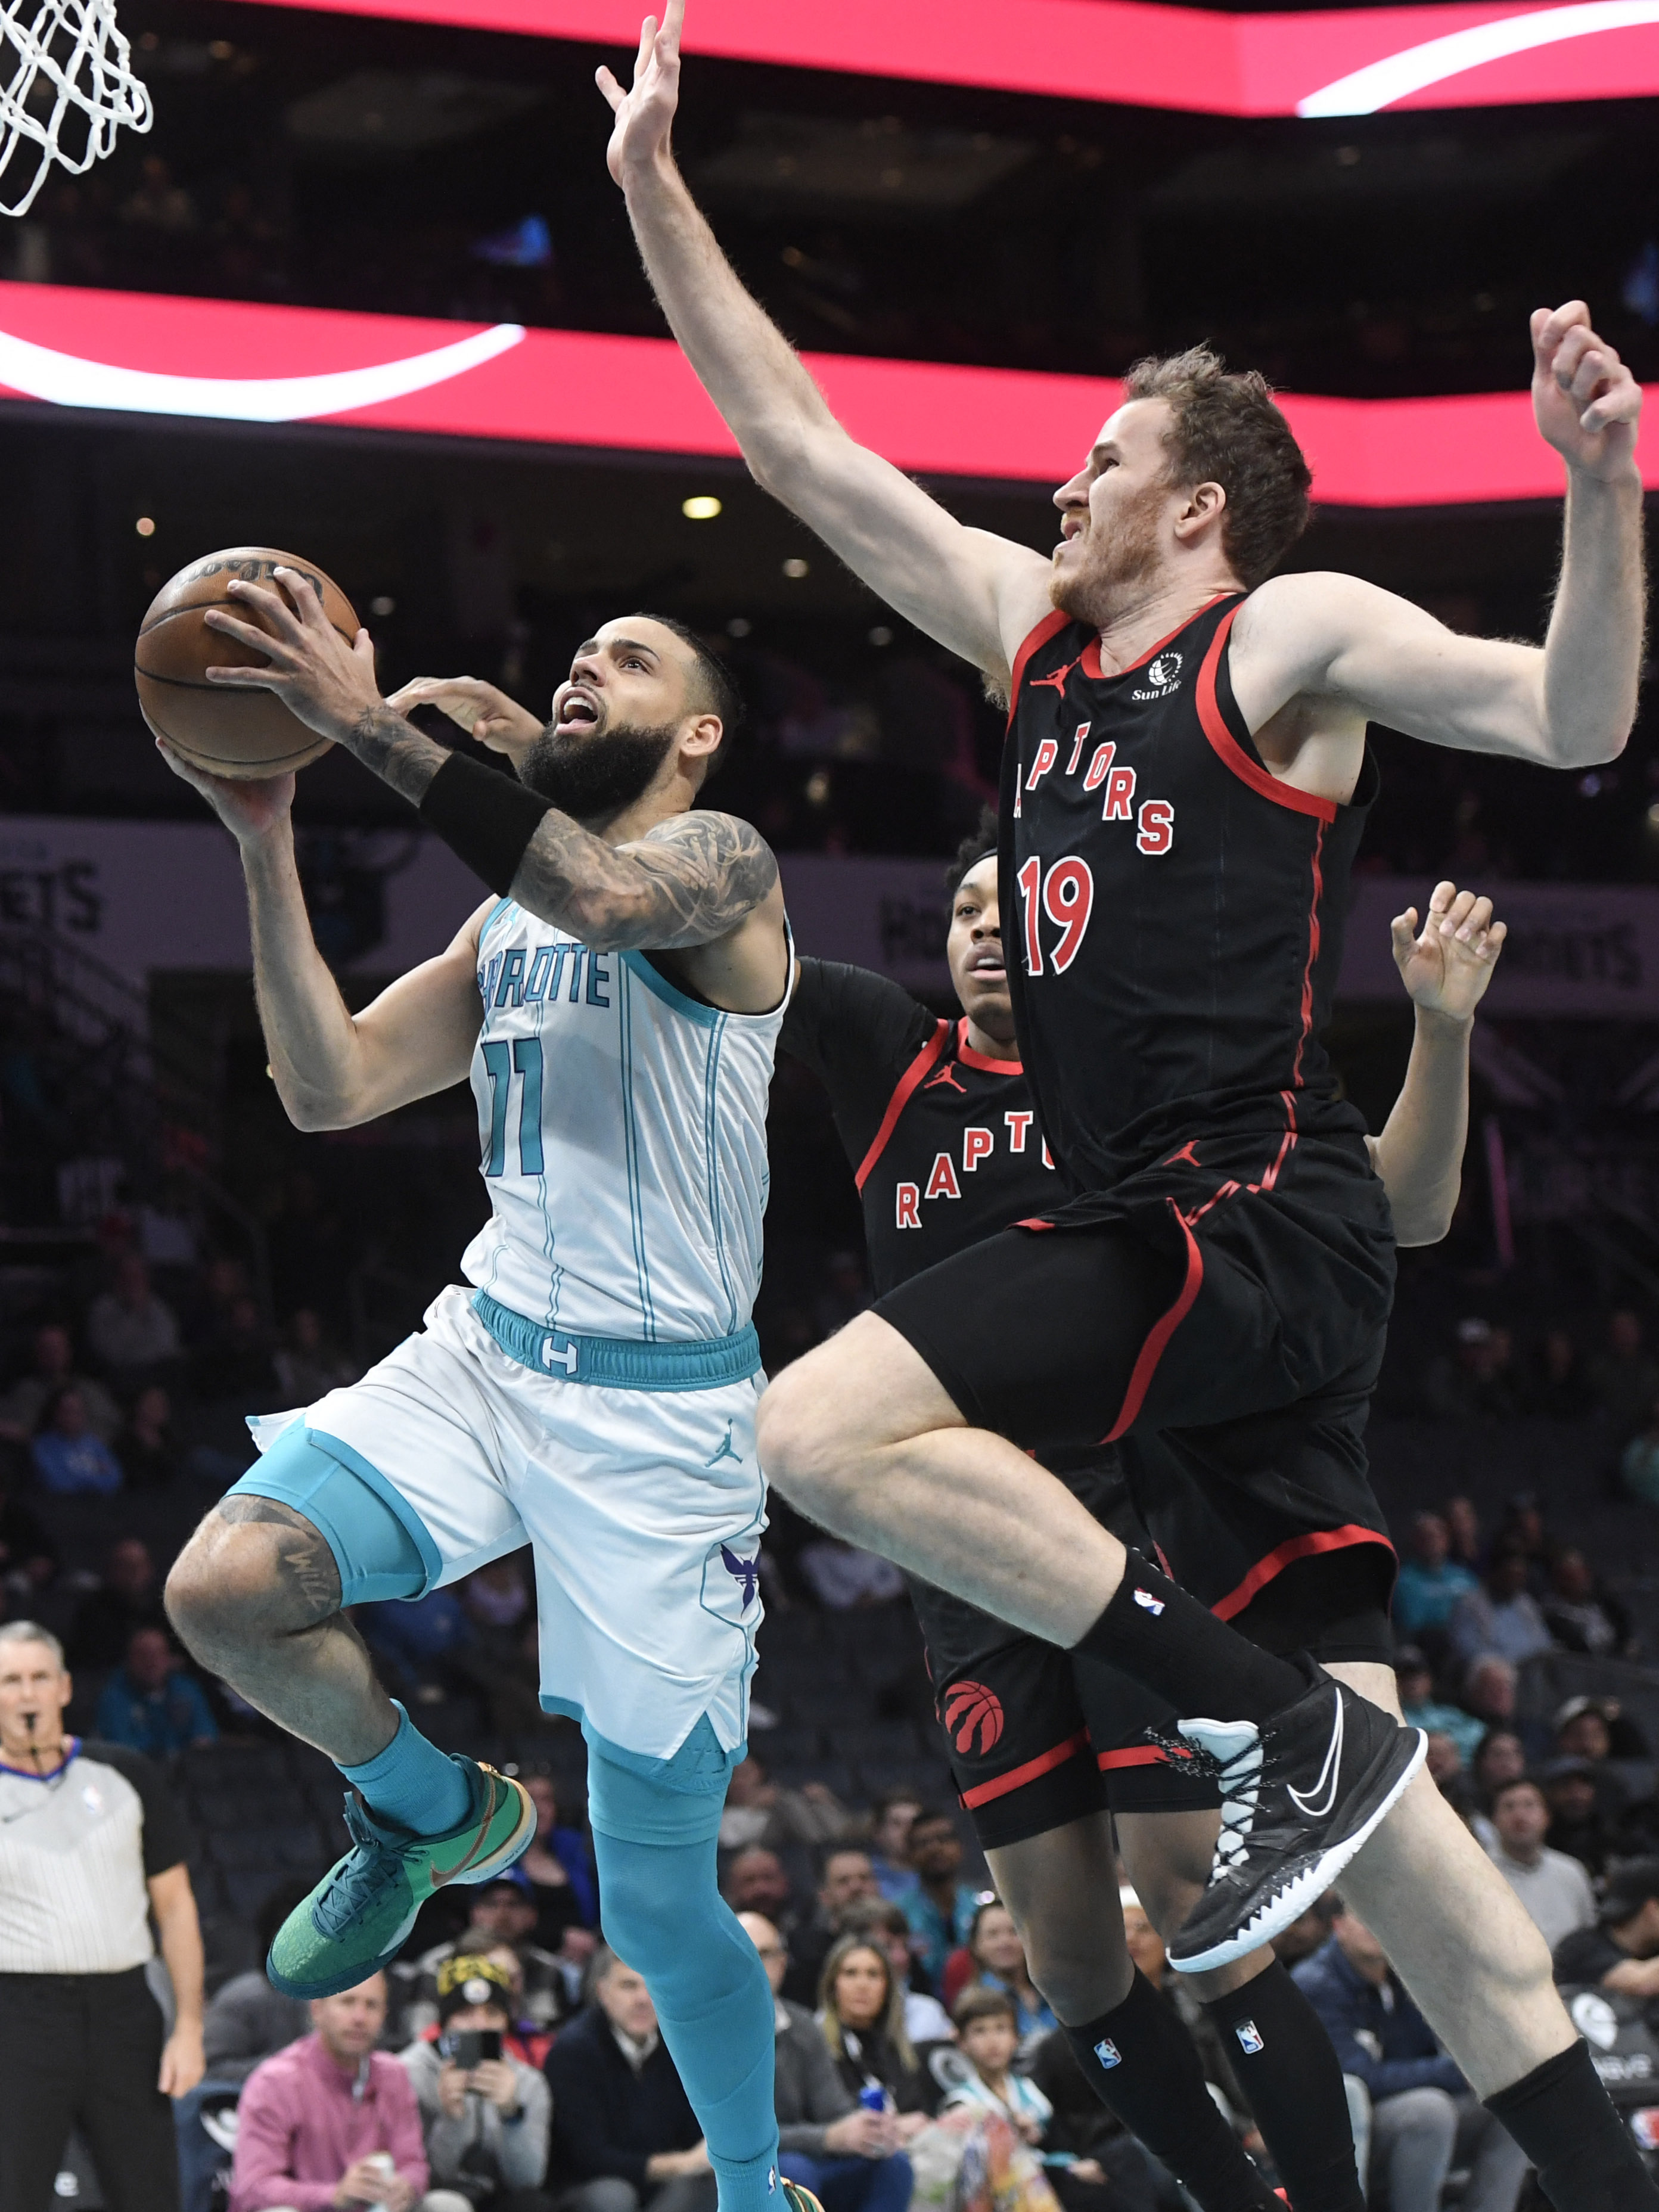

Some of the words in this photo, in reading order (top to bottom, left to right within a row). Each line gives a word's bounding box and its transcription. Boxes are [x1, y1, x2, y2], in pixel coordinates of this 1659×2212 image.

[1132, 689, 1160, 700] Sun
[1017, 856, 1094, 976] 19
[480, 1036, 544, 1178] 11
[541, 1335, 579, 1376] H
